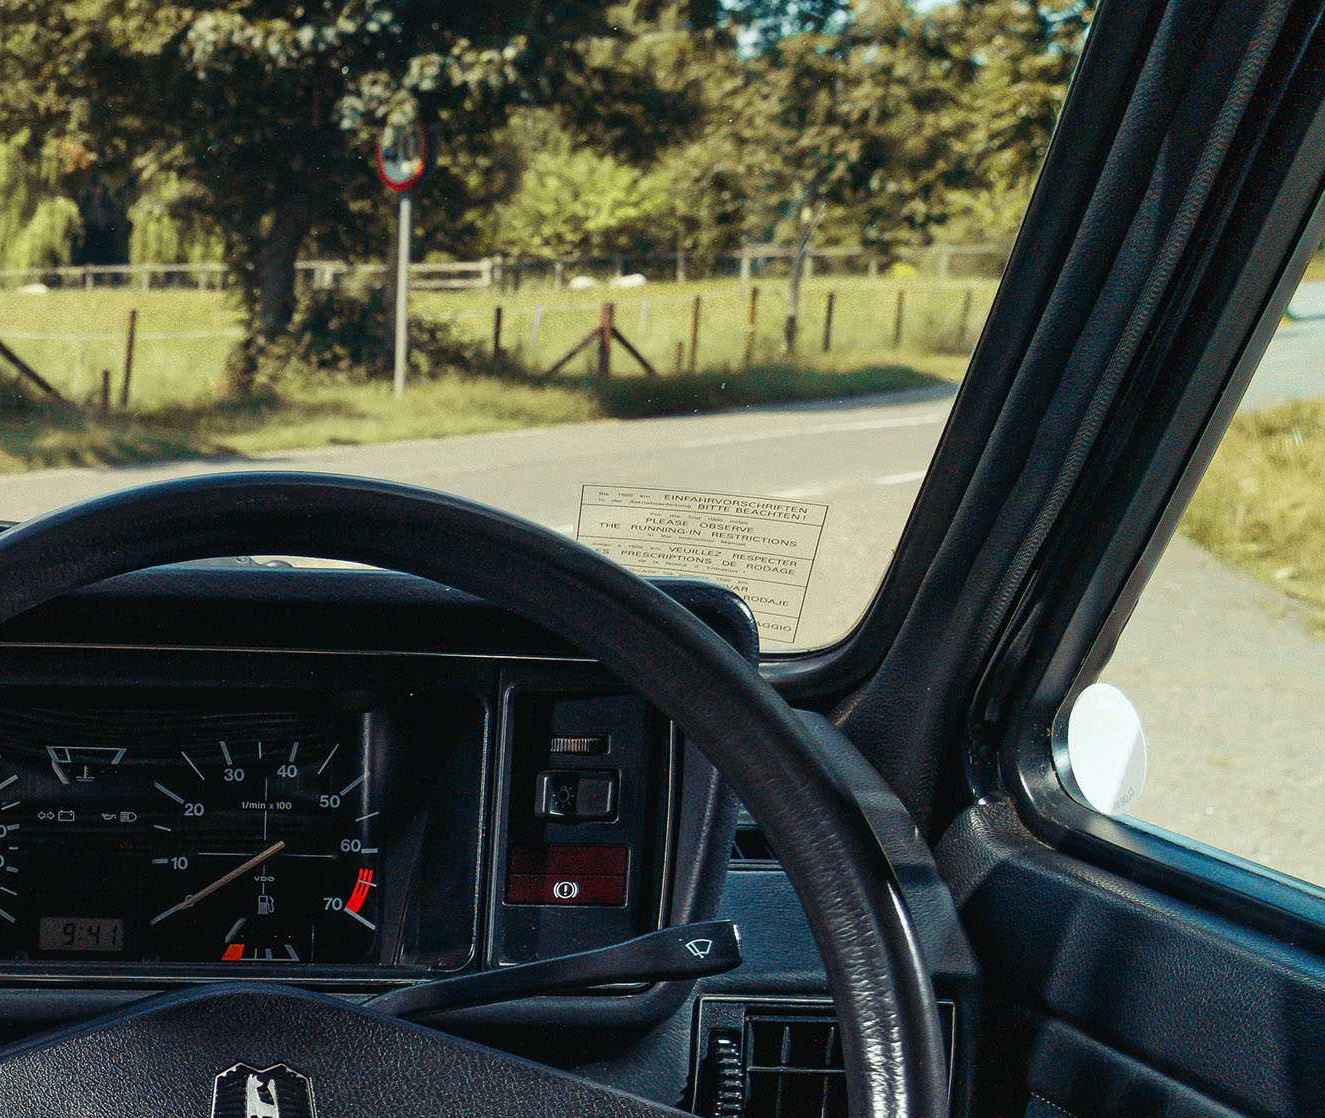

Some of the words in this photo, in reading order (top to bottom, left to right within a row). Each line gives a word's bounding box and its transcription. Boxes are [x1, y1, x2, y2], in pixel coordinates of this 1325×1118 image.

[664, 494, 808, 514] EINFAHRVORSCHRIFTEN
[697, 503, 730, 513] BITTE
[645, 517, 689, 527] PLEASE
[699, 522, 754, 533] OBSERVE
[599, 521, 621, 530] THE
[630, 524, 701, 537] RUNNING-IN
[711, 531, 797, 547] RESTRICTIONS
[620, 550, 712, 565] PRESCRIPTIONS
[722, 560, 737, 568] DE
[746, 564, 796, 576] RODAGE
[668, 546, 722, 558] VEUILLEZ
[732, 553, 797, 567] RESPECTER
[743, 595, 790, 608] RODAJE
[756, 621, 792, 632] AGGIO
[224, 768, 245, 781] 30
[277, 765, 298, 778] 40
[242, 801, 266, 810] 1/min
[276, 801, 292, 810] 100
[319, 795, 340, 808] 50
[184, 803, 204, 816] 20
[341, 839, 361, 852] 60
[171, 857, 189, 870] 10
[323, 897, 342, 911] 70
[63, 923, 118, 946] 9:41
